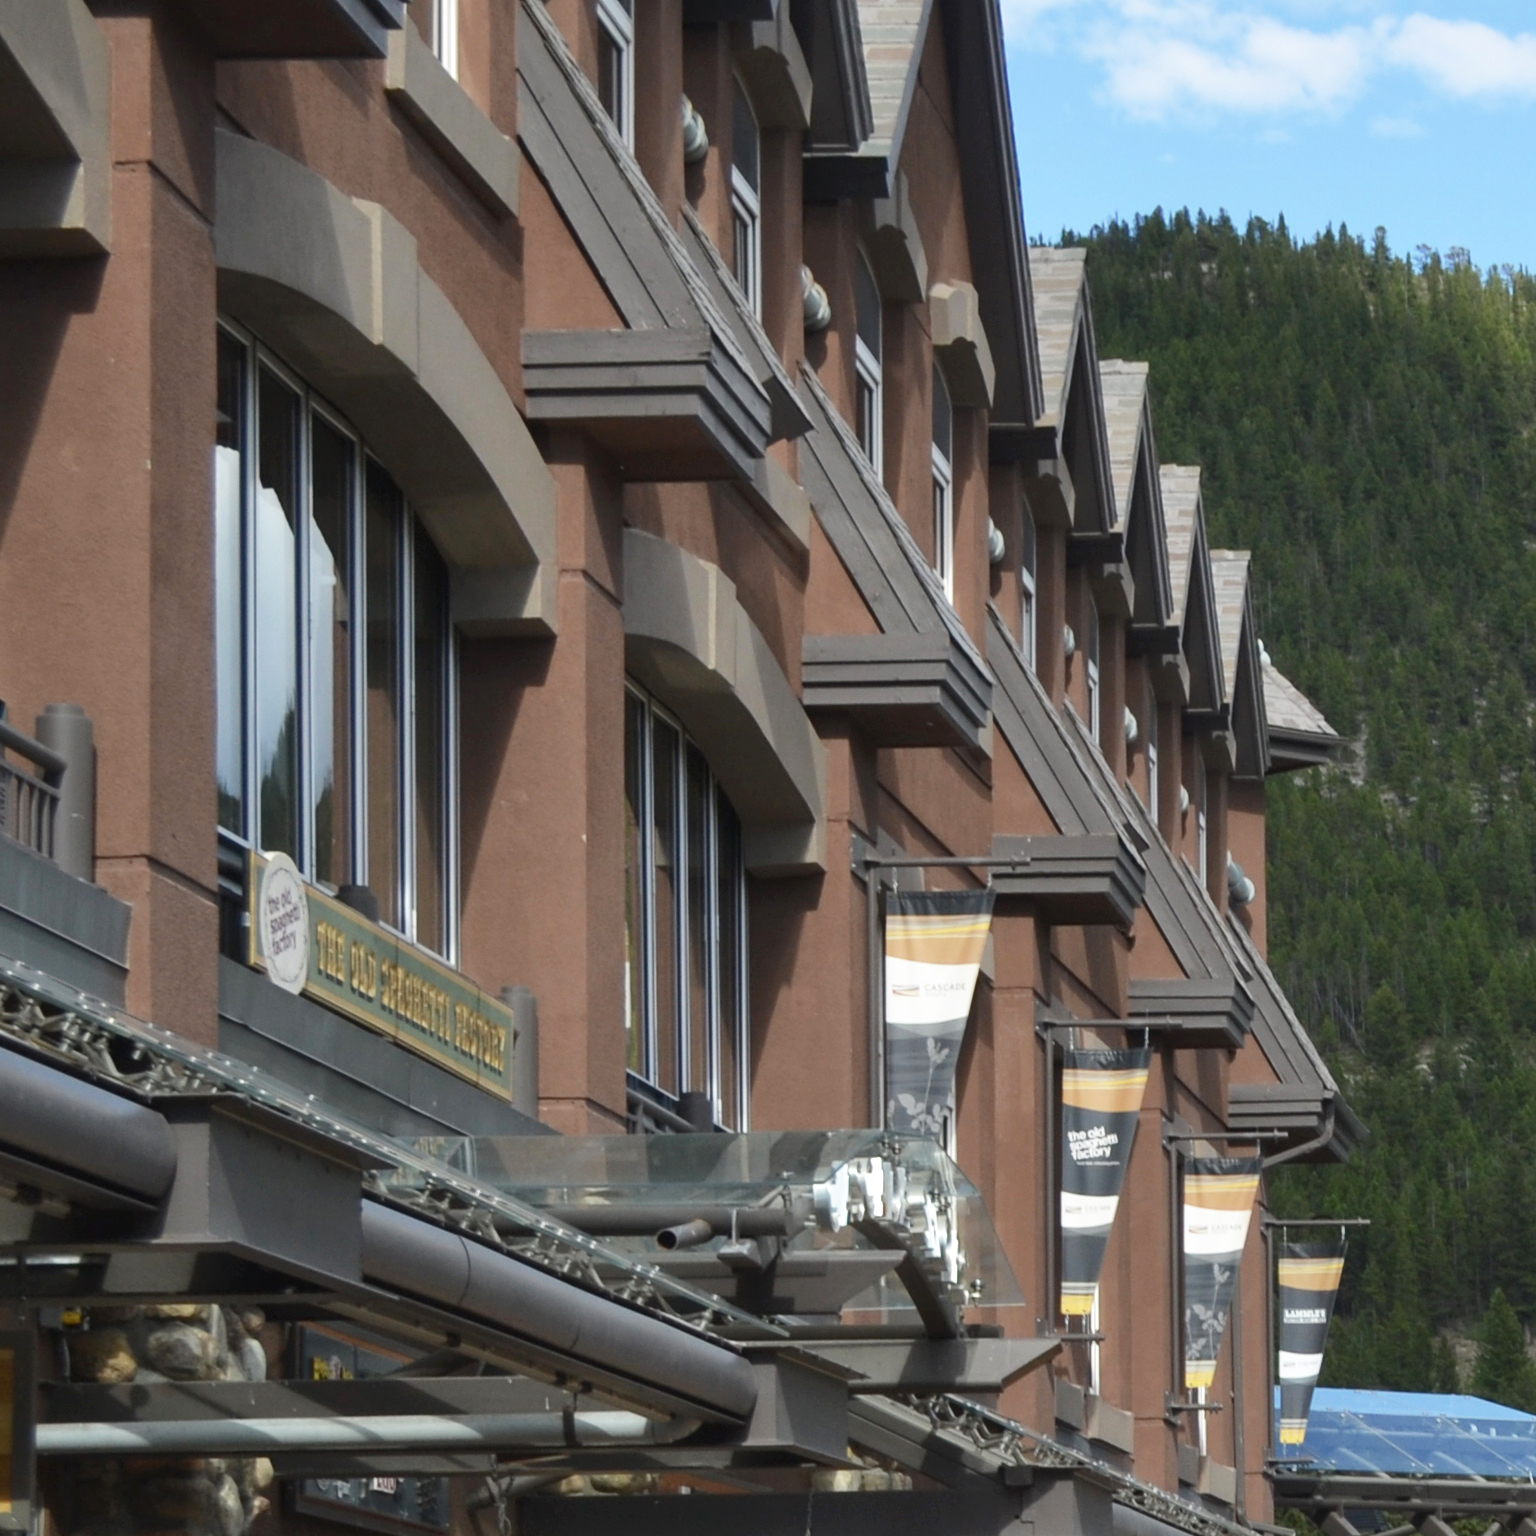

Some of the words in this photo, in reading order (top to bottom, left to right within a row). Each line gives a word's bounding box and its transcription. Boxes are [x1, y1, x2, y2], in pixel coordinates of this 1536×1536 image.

[923, 982, 967, 992] CASCADE
[316, 920, 346, 986] THE
[351, 941, 377, 1002] OLD
[381, 957, 450, 1044] SPAGHETTI
[454, 1003, 506, 1075] FACTORY
[1067, 1130, 1087, 1142] the
[1088, 1126, 1106, 1139] old
[1069, 1132, 1119, 1152] spaghetti
[1071, 1145, 1112, 1161] factory
